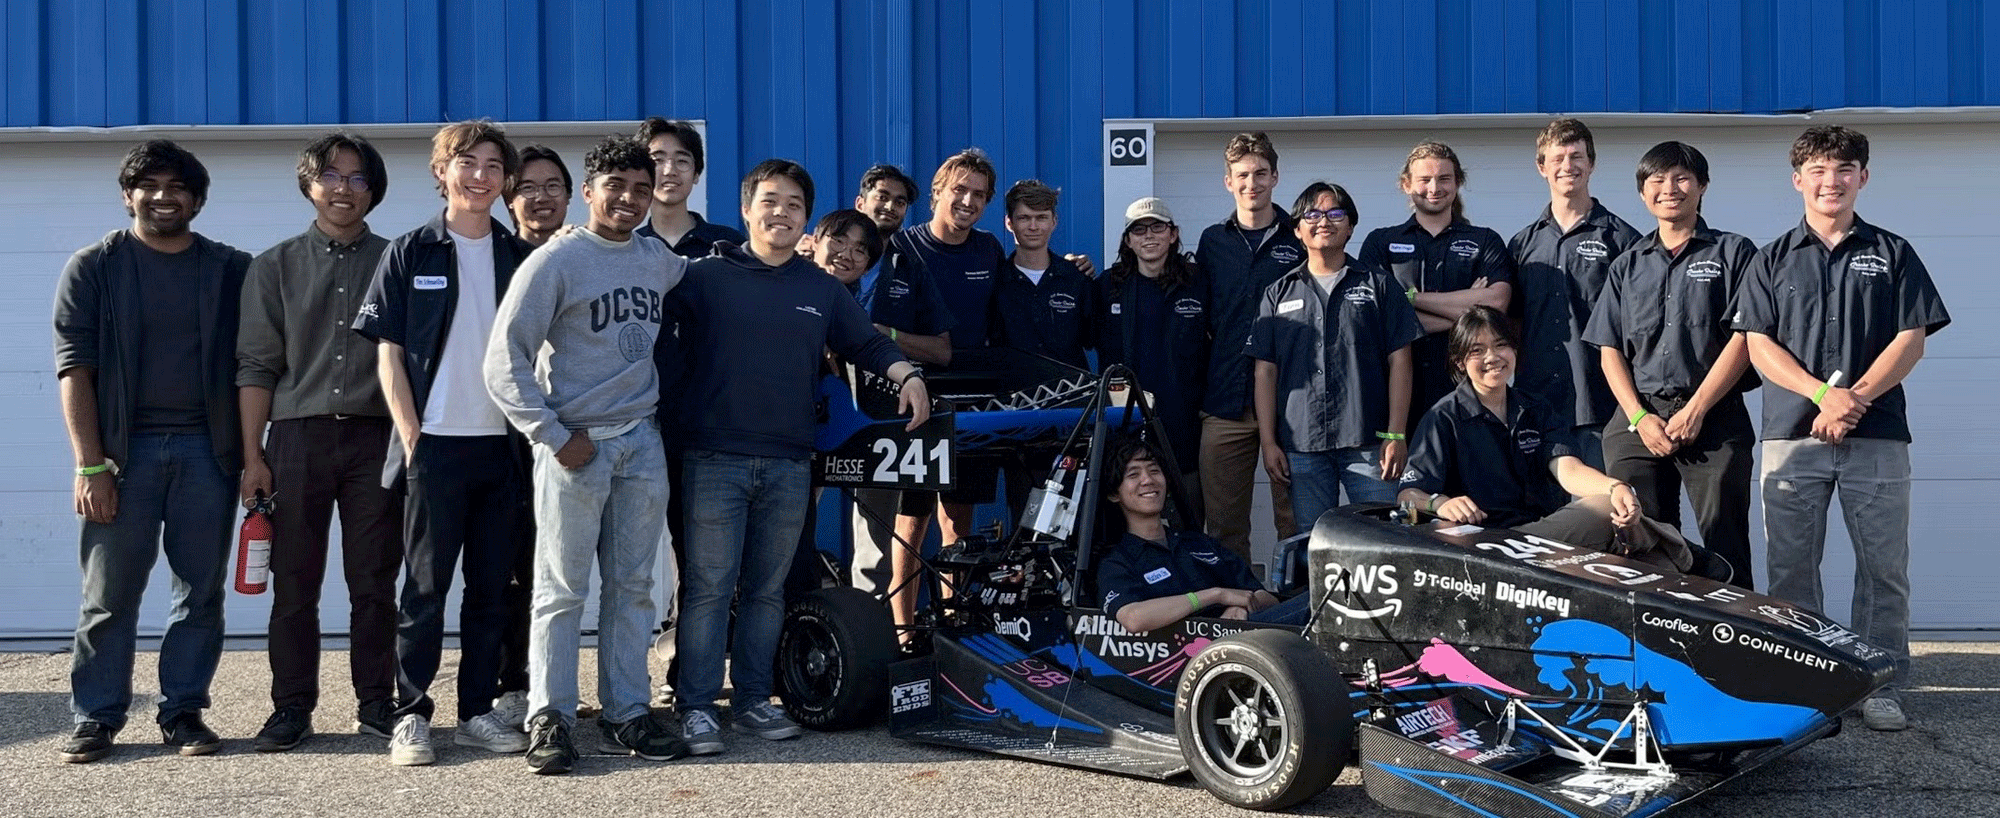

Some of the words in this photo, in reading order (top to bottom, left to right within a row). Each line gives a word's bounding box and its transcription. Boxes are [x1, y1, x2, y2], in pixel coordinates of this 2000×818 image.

[1111, 137, 1146, 158] 60
[590, 286, 662, 333] UCSB
[872, 438, 950, 485] 241
[1475, 534, 1576, 560] 241
[1324, 563, 1399, 595] aws
[1495, 581, 1571, 618] DigiKey
[993, 612, 1032, 642] SemiQ
[1185, 620, 1209, 636] UC
[1642, 612, 1699, 635] Coroflex
[1099, 634, 1170, 662] Ansys
[1738, 634, 1839, 672] CONFLUENT
[1003, 659, 1048, 676] UC
[1027, 671, 1070, 688] SB
[893, 700, 929, 714] ENDS
[900, 694, 929, 706] ROD
[1394, 704, 1452, 735] AIRTECH
